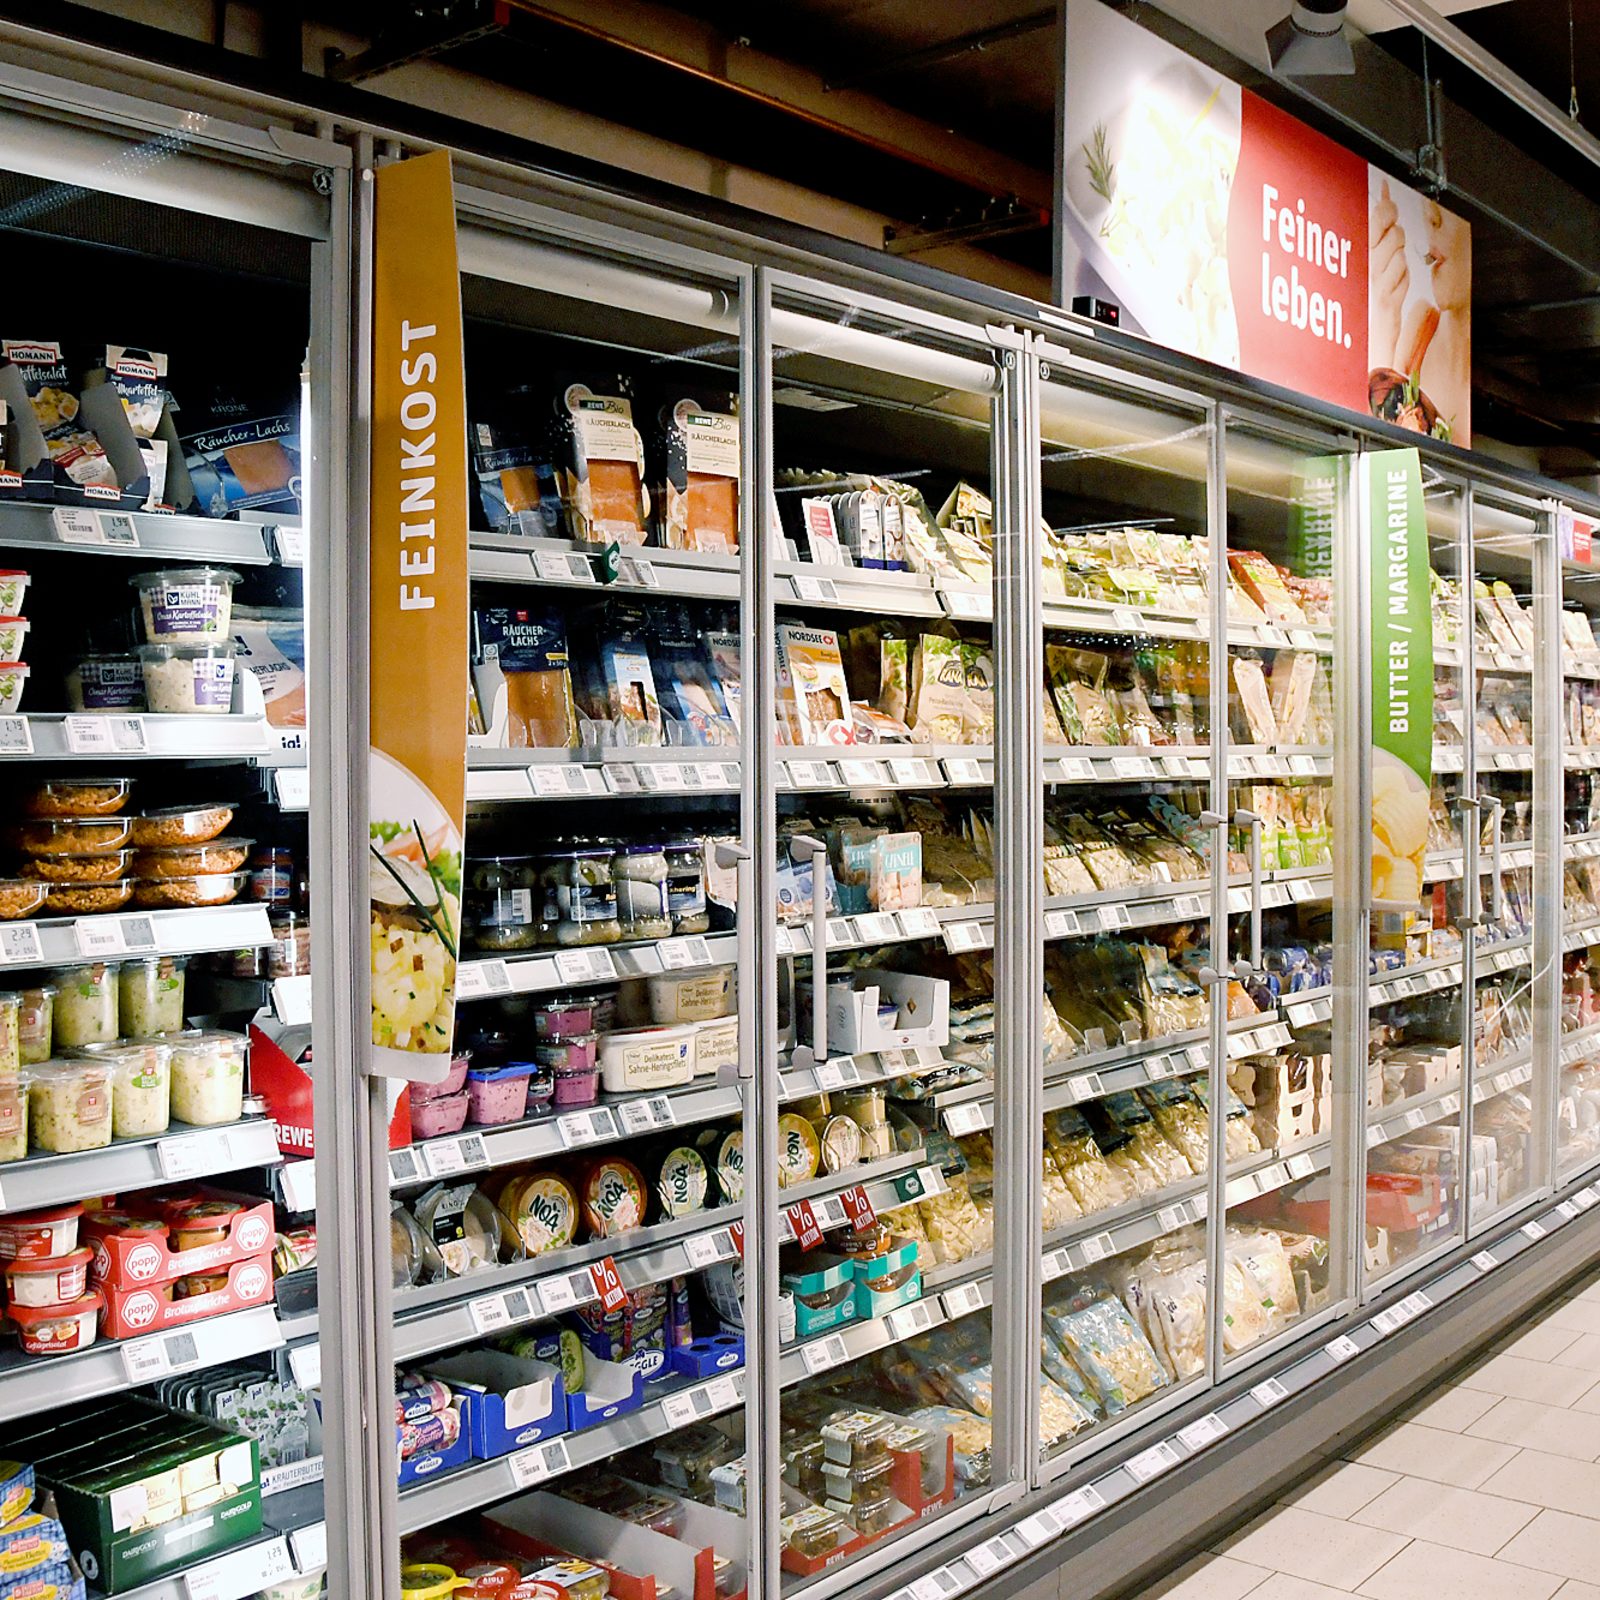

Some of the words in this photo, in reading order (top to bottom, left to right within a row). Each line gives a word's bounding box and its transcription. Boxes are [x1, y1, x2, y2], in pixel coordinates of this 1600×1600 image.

[1263, 184, 1352, 279] Feiner
[1262, 252, 1353, 349] leben.
[11, 350, 54, 361] HOMANN
[19, 363, 68, 383] toffelsalat
[118, 364, 155, 377] HOMANN
[604, 400, 624, 414] Bio
[712, 417, 732, 431] Bio
[193, 419, 291, 450] Räucher-Lachs
[400, 319, 437, 611] FEINKOST
[86, 487, 119, 498] HOMANN
[1387, 468, 1409, 616] MARGARINE
[510, 635, 540, 647] LACHS
[788, 630, 823, 644] NORDSEE
[1389, 640, 1410, 733] BUTTER
[644, 1052, 675, 1063] Delikatess
[276, 1124, 314, 1148] REWE
[845, 1187, 868, 1214] %
[790, 1202, 813, 1231] %
[242, 1226, 265, 1241] popp
[131, 1254, 157, 1270] popp
[594, 1259, 617, 1290] %
[127, 1302, 154, 1318] popp
[222, 1395, 233, 1408] ja!
[252, 1387, 263, 1400] ja!
[418, 1458, 439, 1471] MEGGLE
[921, 1499, 943, 1518] REWE
[482, 1576, 504, 1585] AIOLI
